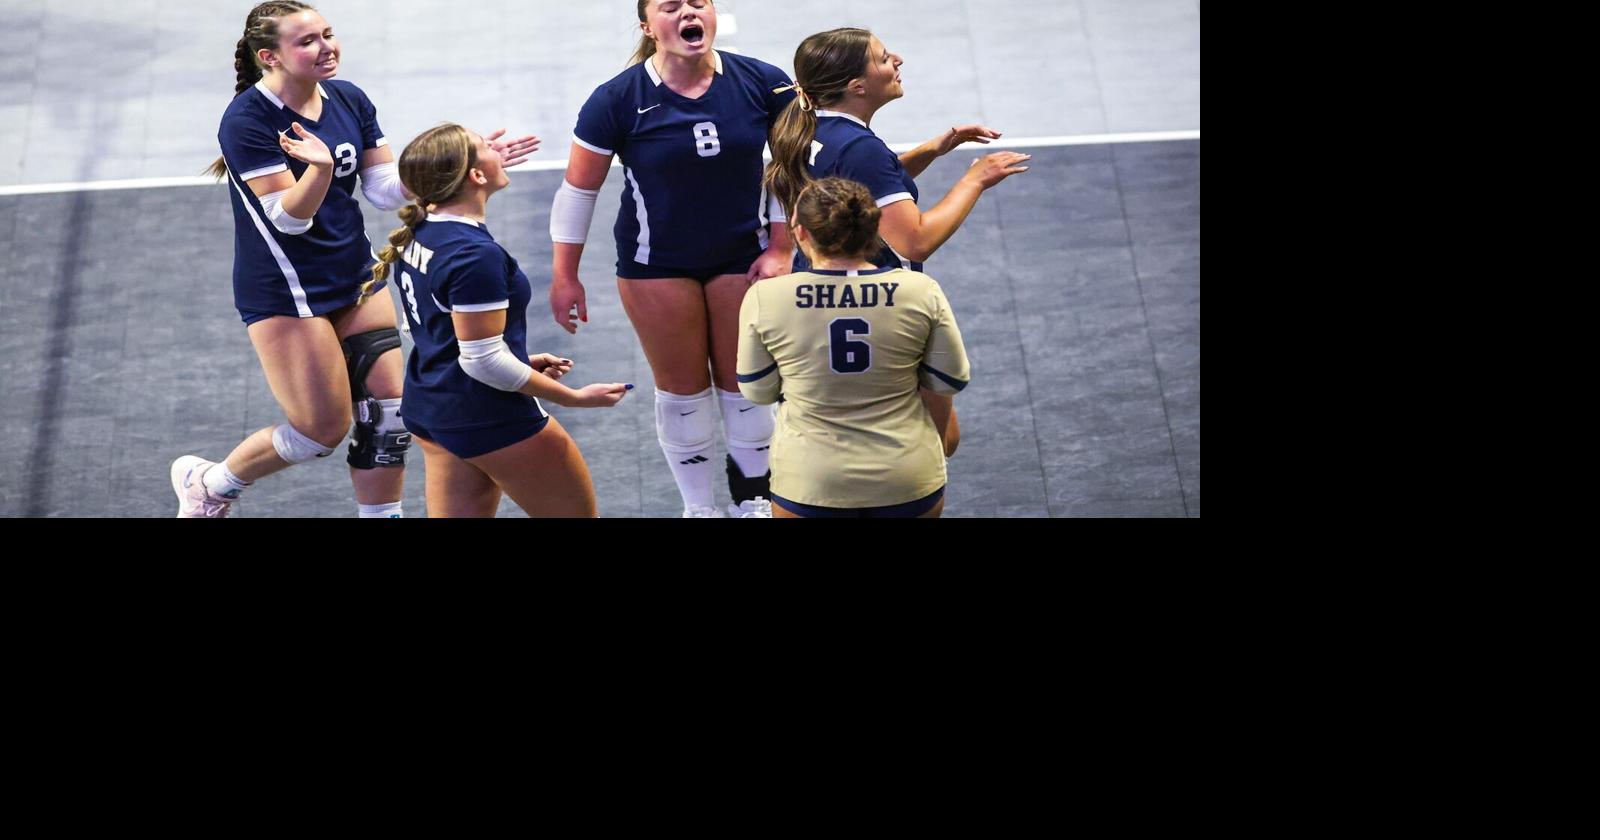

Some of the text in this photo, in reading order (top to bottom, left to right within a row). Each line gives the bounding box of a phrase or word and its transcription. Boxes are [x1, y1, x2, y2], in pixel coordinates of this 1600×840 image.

[693, 121, 720, 157] 8
[796, 282, 899, 309] SHADY
[828, 317, 871, 374] 6
